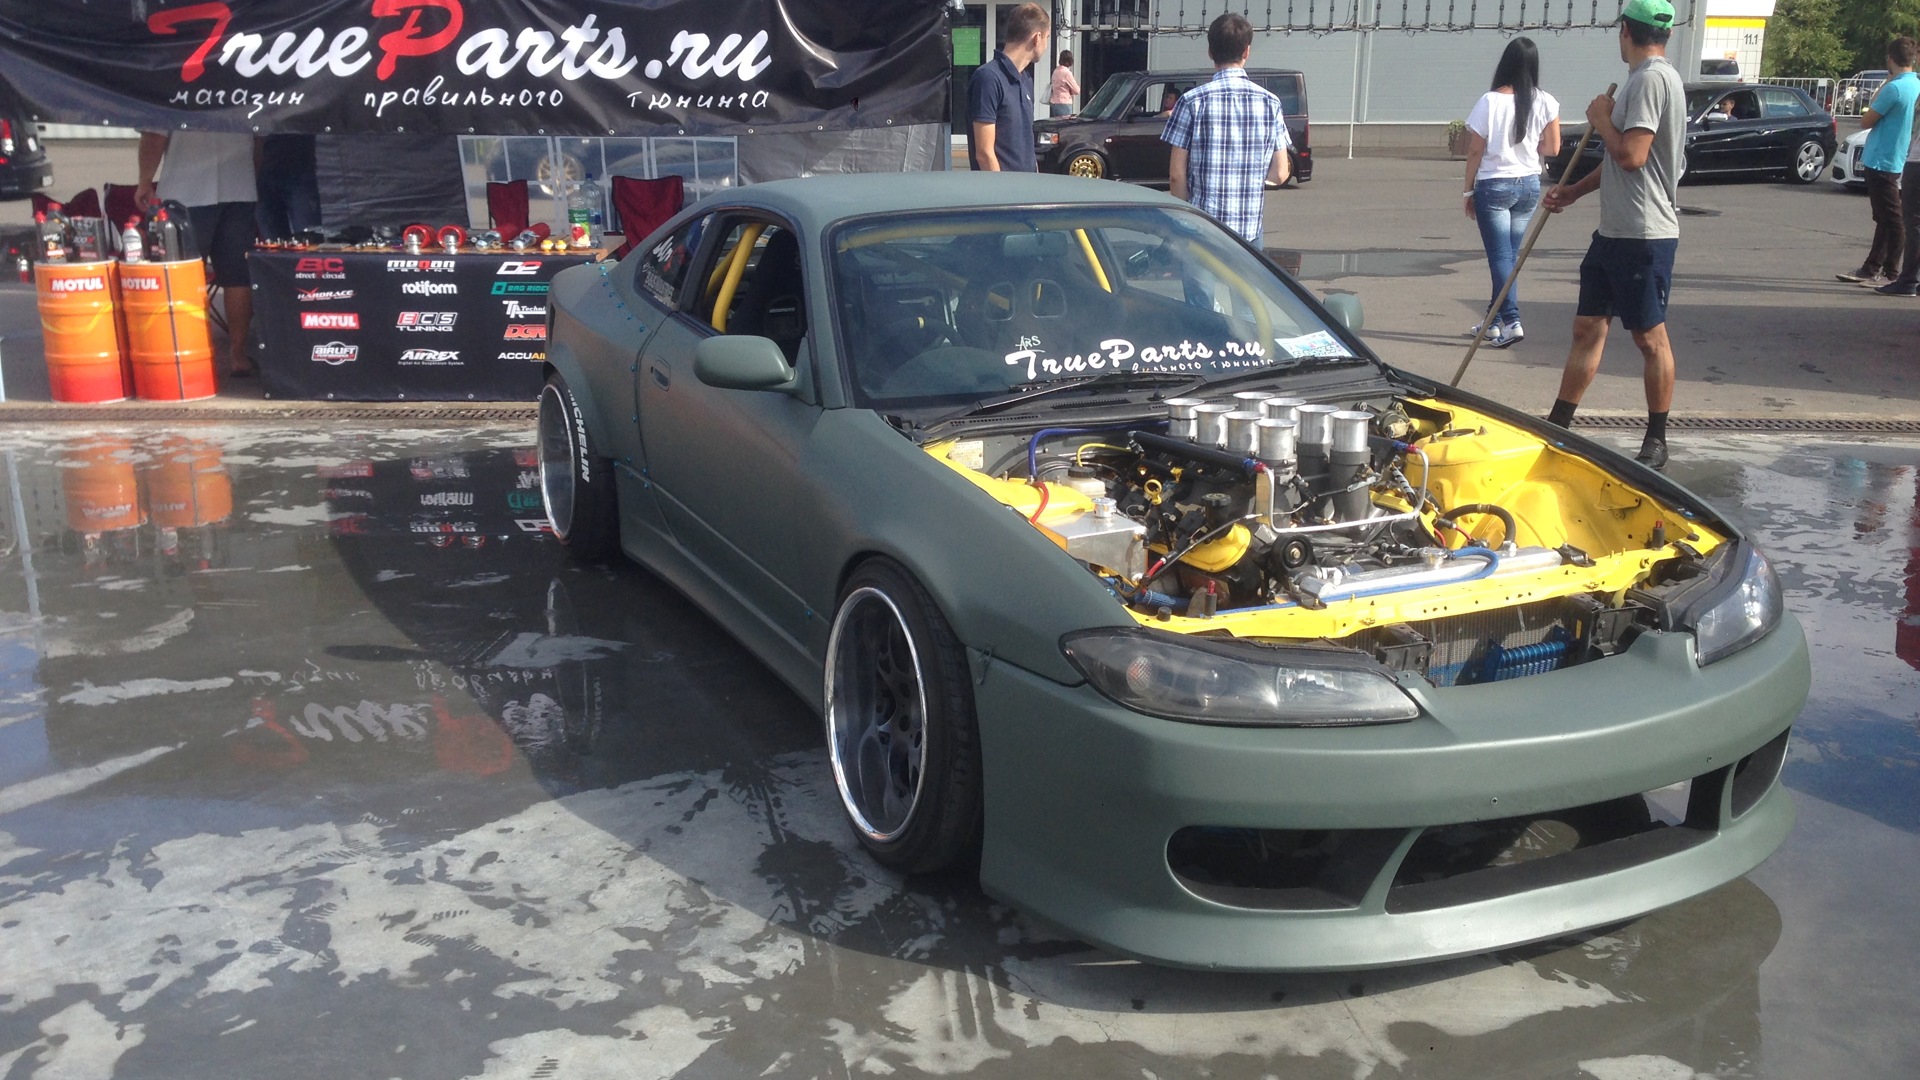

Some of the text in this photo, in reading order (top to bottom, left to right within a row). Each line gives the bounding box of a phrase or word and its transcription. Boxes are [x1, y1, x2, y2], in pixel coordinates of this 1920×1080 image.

[148, 0, 772, 83] TrueParts.ru
[1743, 33, 1759, 46] 11.1
[169, 75, 770, 119] магазин правильного тюнинга
[295, 257, 345, 273] BC
[51, 277, 104, 293] MOTUL
[401, 280, 458, 297] rotiform
[304, 314, 357, 327] MOTUL
[396, 311, 459, 326] ECS
[1004, 338, 1266, 381] TrueParts.ru
